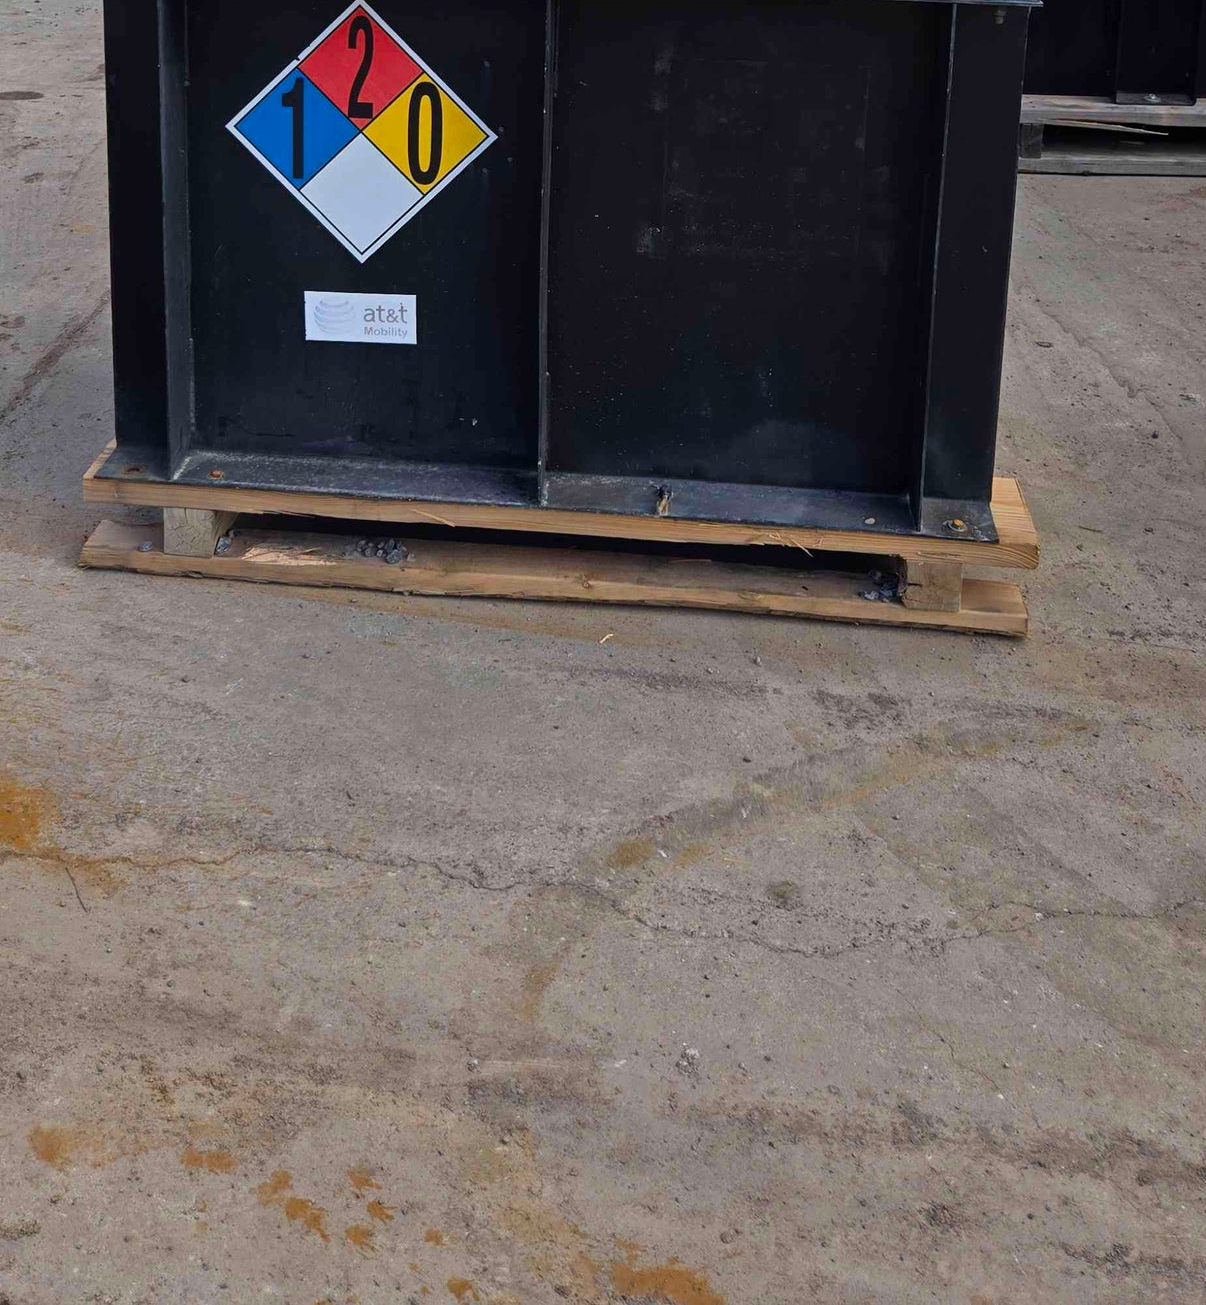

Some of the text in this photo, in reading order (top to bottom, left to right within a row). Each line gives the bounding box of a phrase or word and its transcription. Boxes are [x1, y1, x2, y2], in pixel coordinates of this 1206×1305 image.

[347, 15, 374, 118] 2
[281, 77, 305, 180] 1
[407, 81, 443, 186] 0
[363, 302, 408, 324] at&t
[363, 326, 408, 339] Mobility
